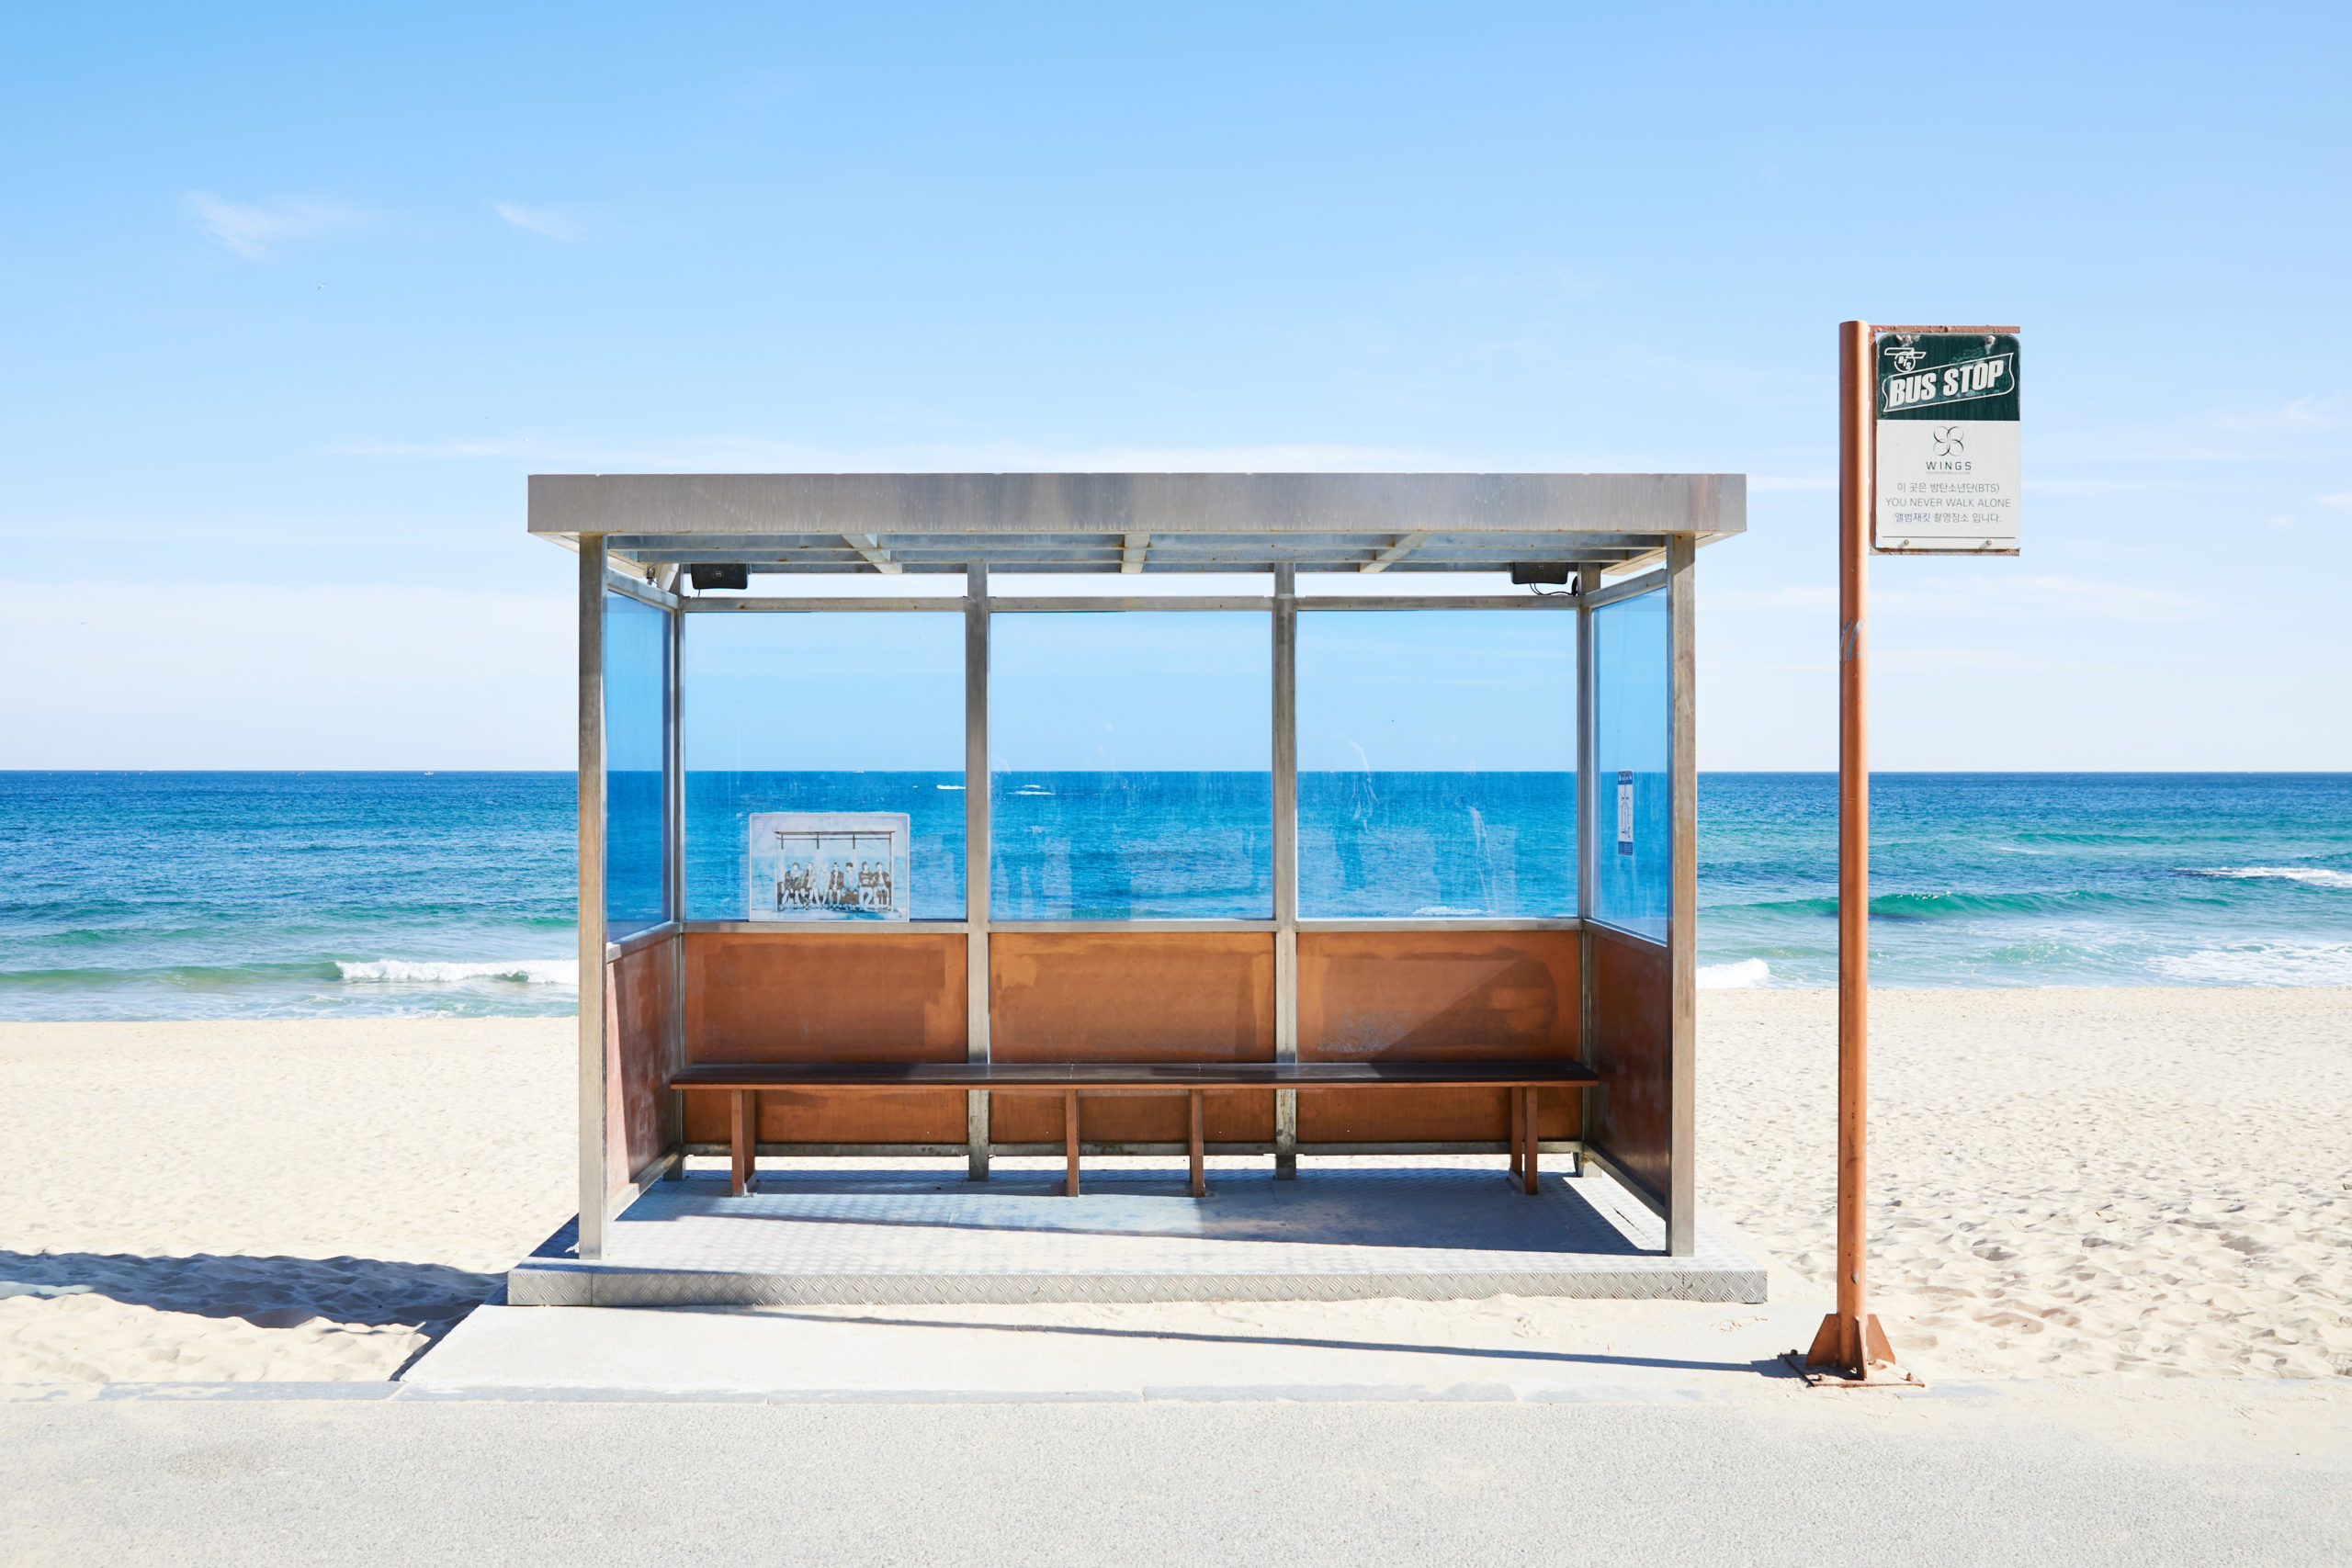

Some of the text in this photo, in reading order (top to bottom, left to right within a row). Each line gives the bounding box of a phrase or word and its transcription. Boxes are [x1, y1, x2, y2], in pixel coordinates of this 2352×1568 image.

[1898, 355, 1912, 371] BTS
[1889, 360, 2004, 407] BUS STOP
[1926, 461, 1972, 471] WINGS
[1897, 482, 2000, 493] 이 곳은 방탄소년단(BTS)
[1885, 497, 2011, 508] YOU NEVER WALK ALONE
[1894, 512, 1931, 523] 앨범재킷
